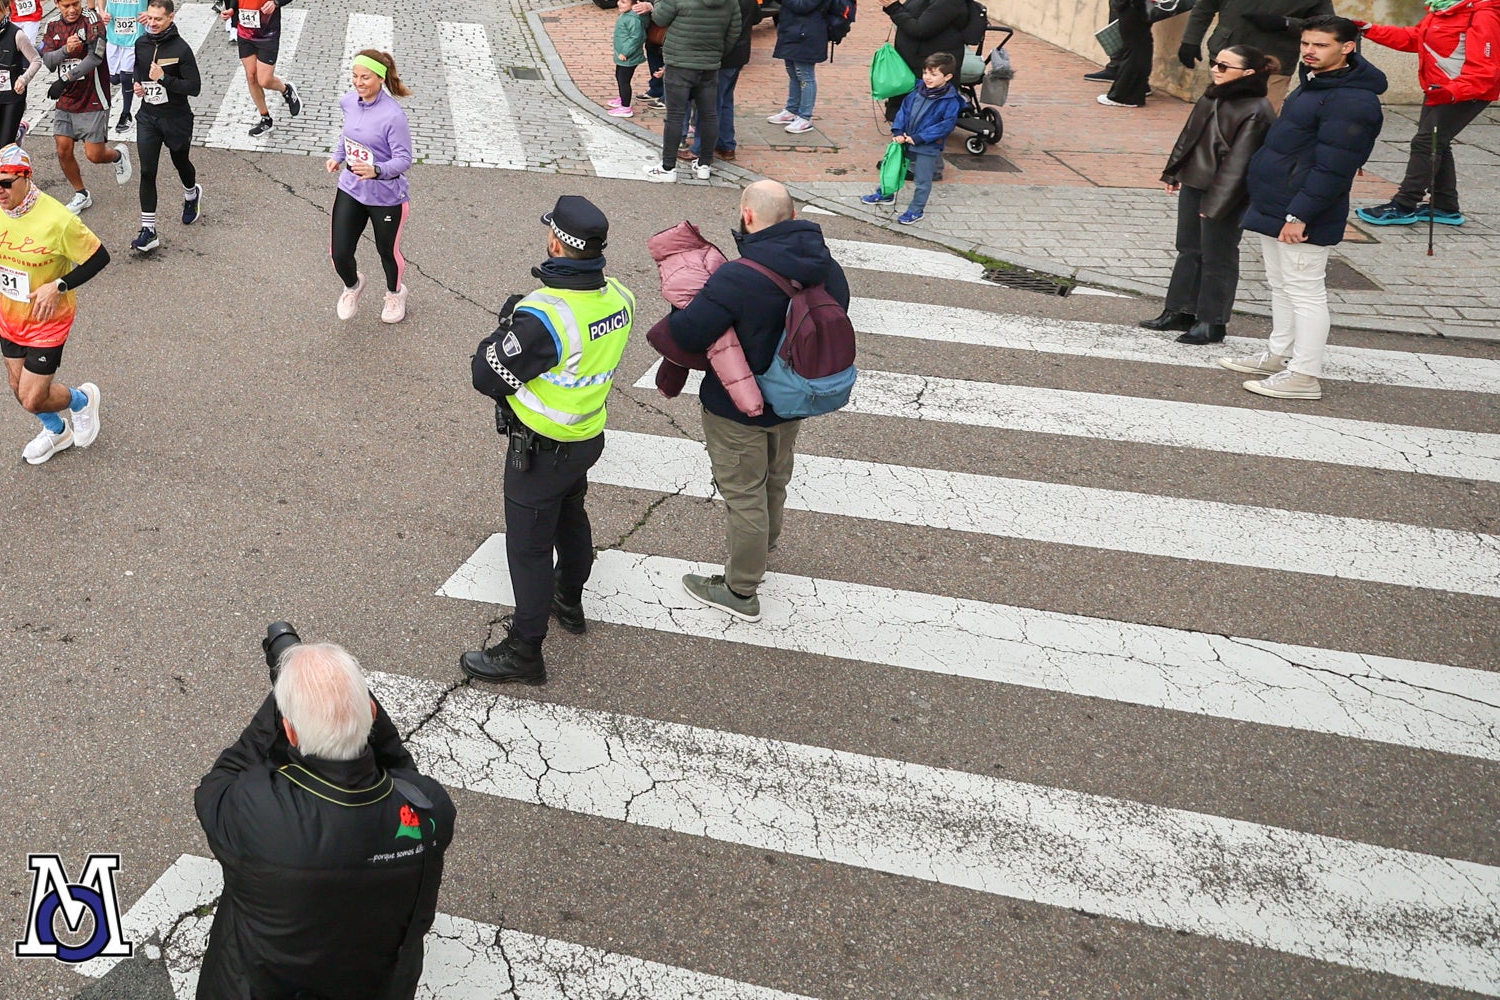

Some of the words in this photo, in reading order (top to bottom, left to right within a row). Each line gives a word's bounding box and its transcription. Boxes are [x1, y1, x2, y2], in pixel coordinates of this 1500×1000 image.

[241, 13, 256, 21] 341
[116, 20, 134, 29] 302
[346, 144, 369, 161] 343
[1, 274, 18, 289] 31
